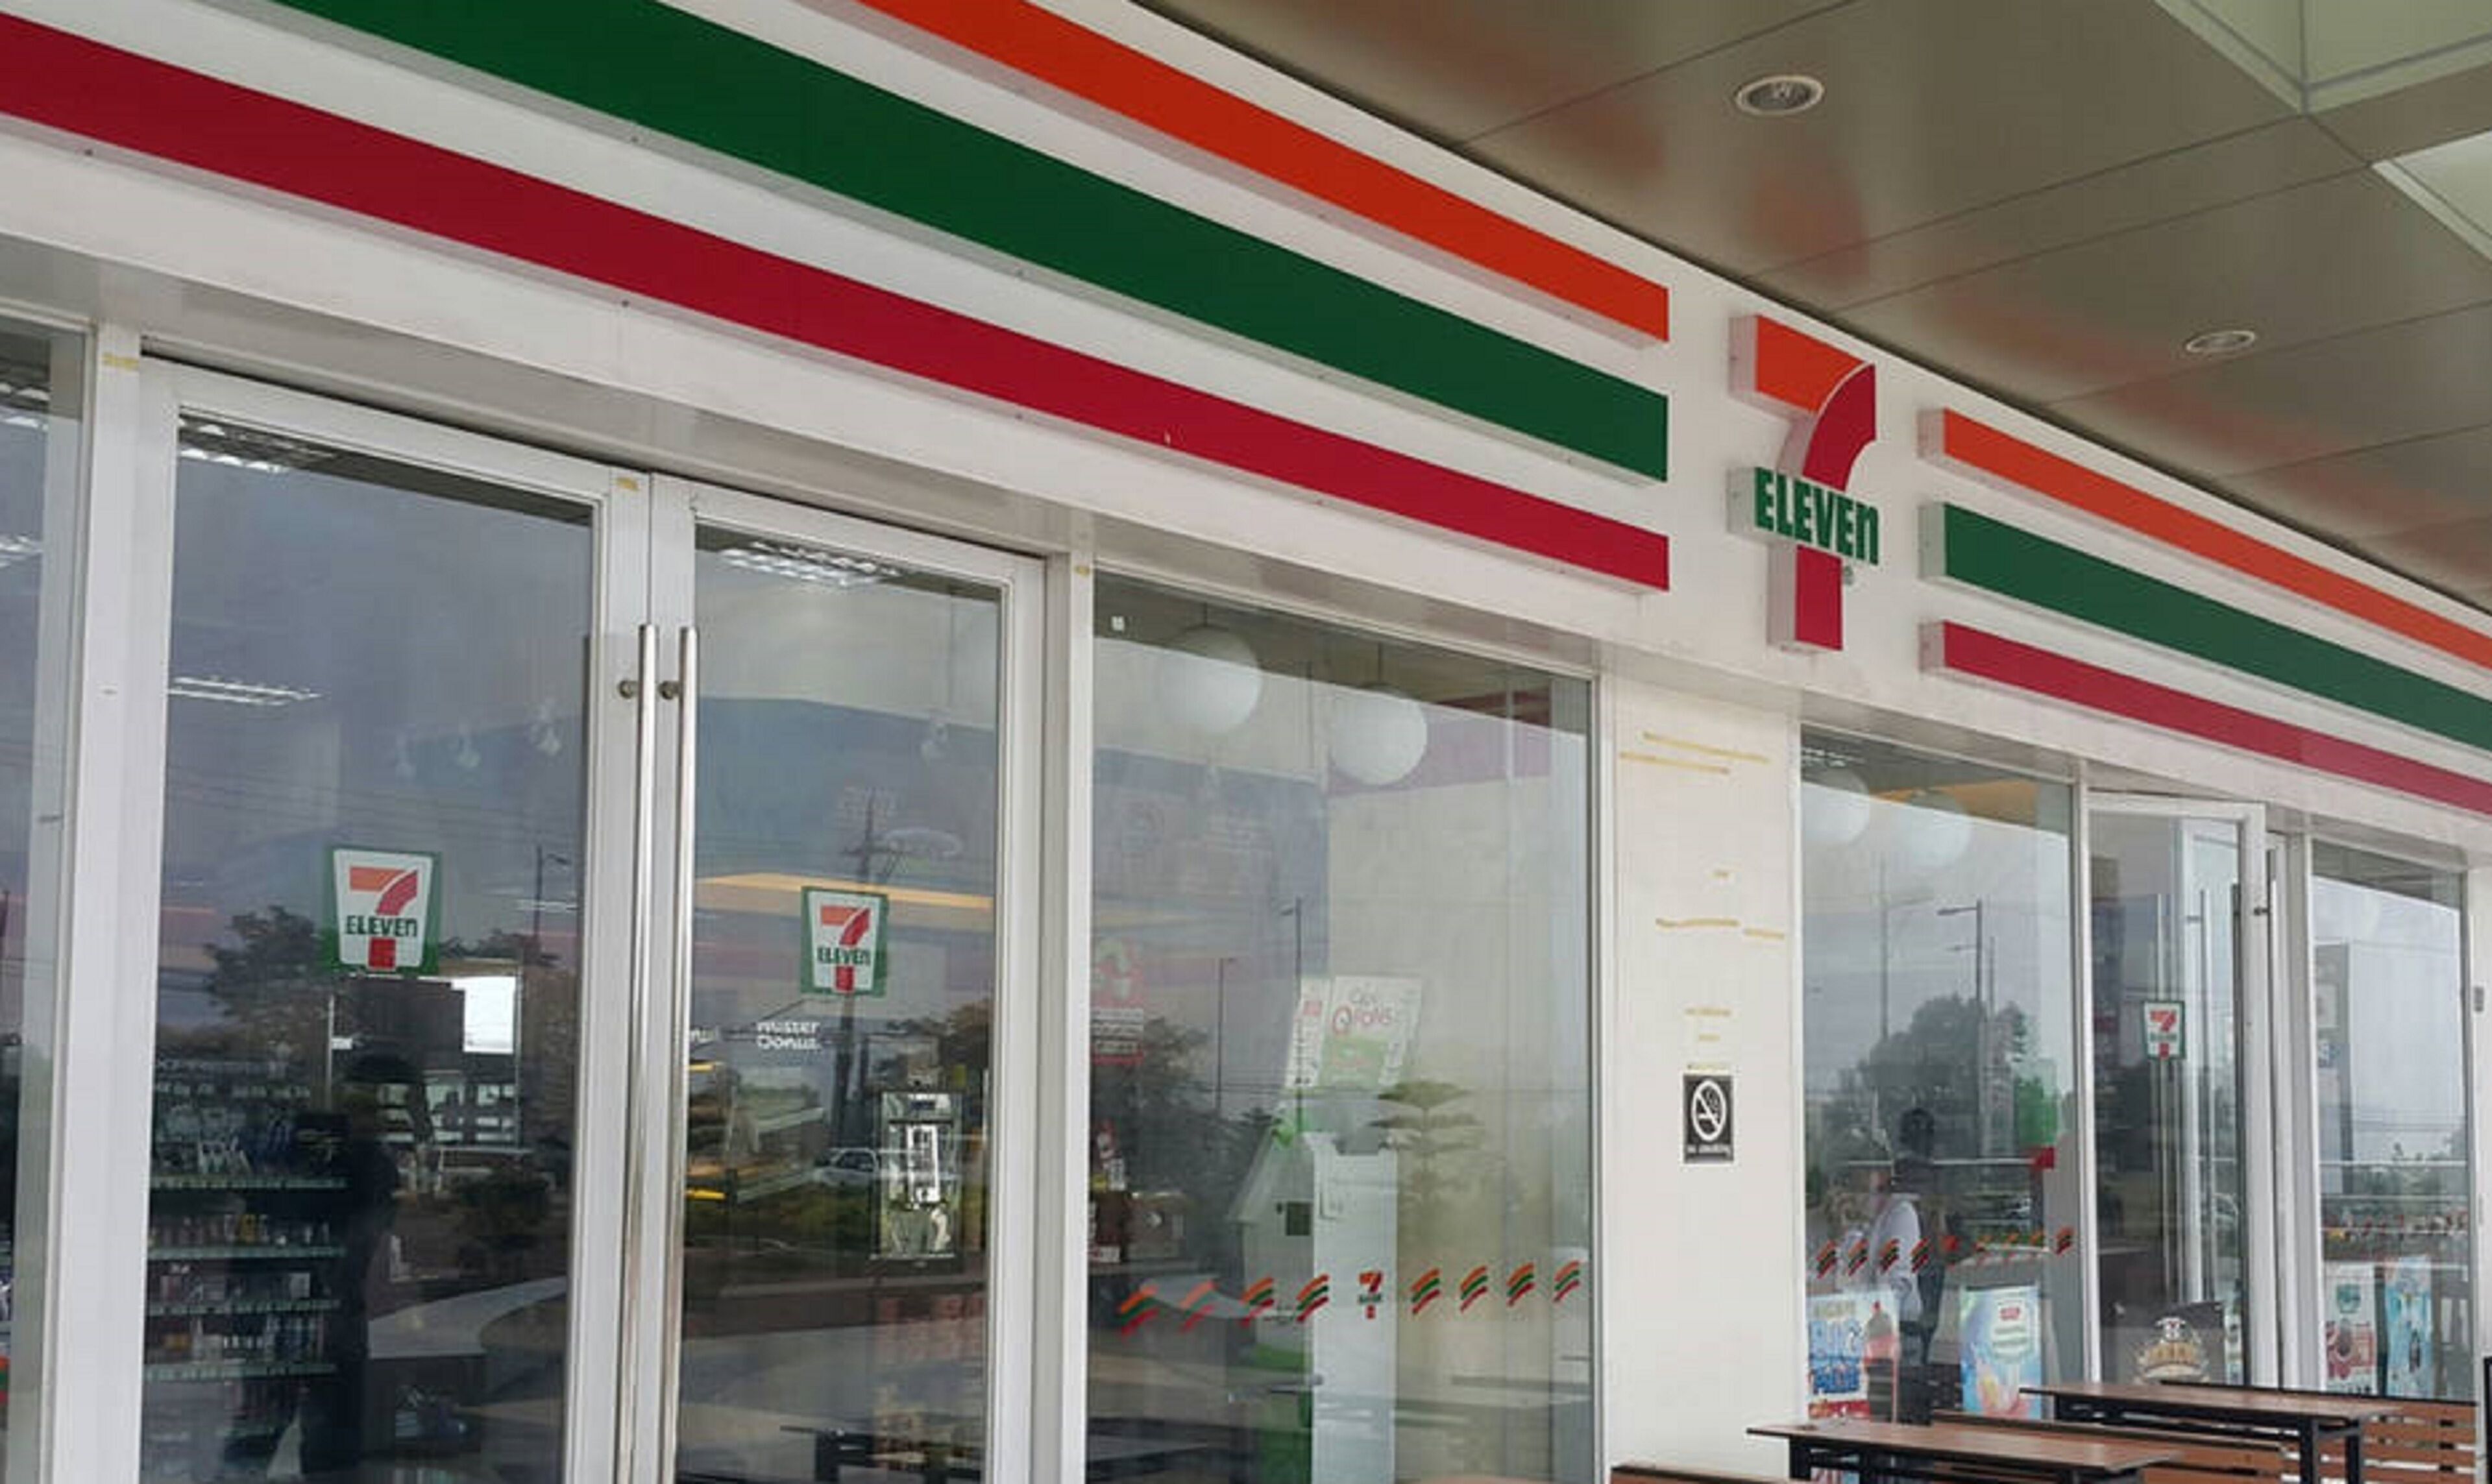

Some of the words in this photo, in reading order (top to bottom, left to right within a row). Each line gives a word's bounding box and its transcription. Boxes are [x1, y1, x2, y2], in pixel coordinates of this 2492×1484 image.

[1755, 315, 1876, 651] 7
[350, 865, 417, 969] 7
[821, 906, 870, 992] 7
